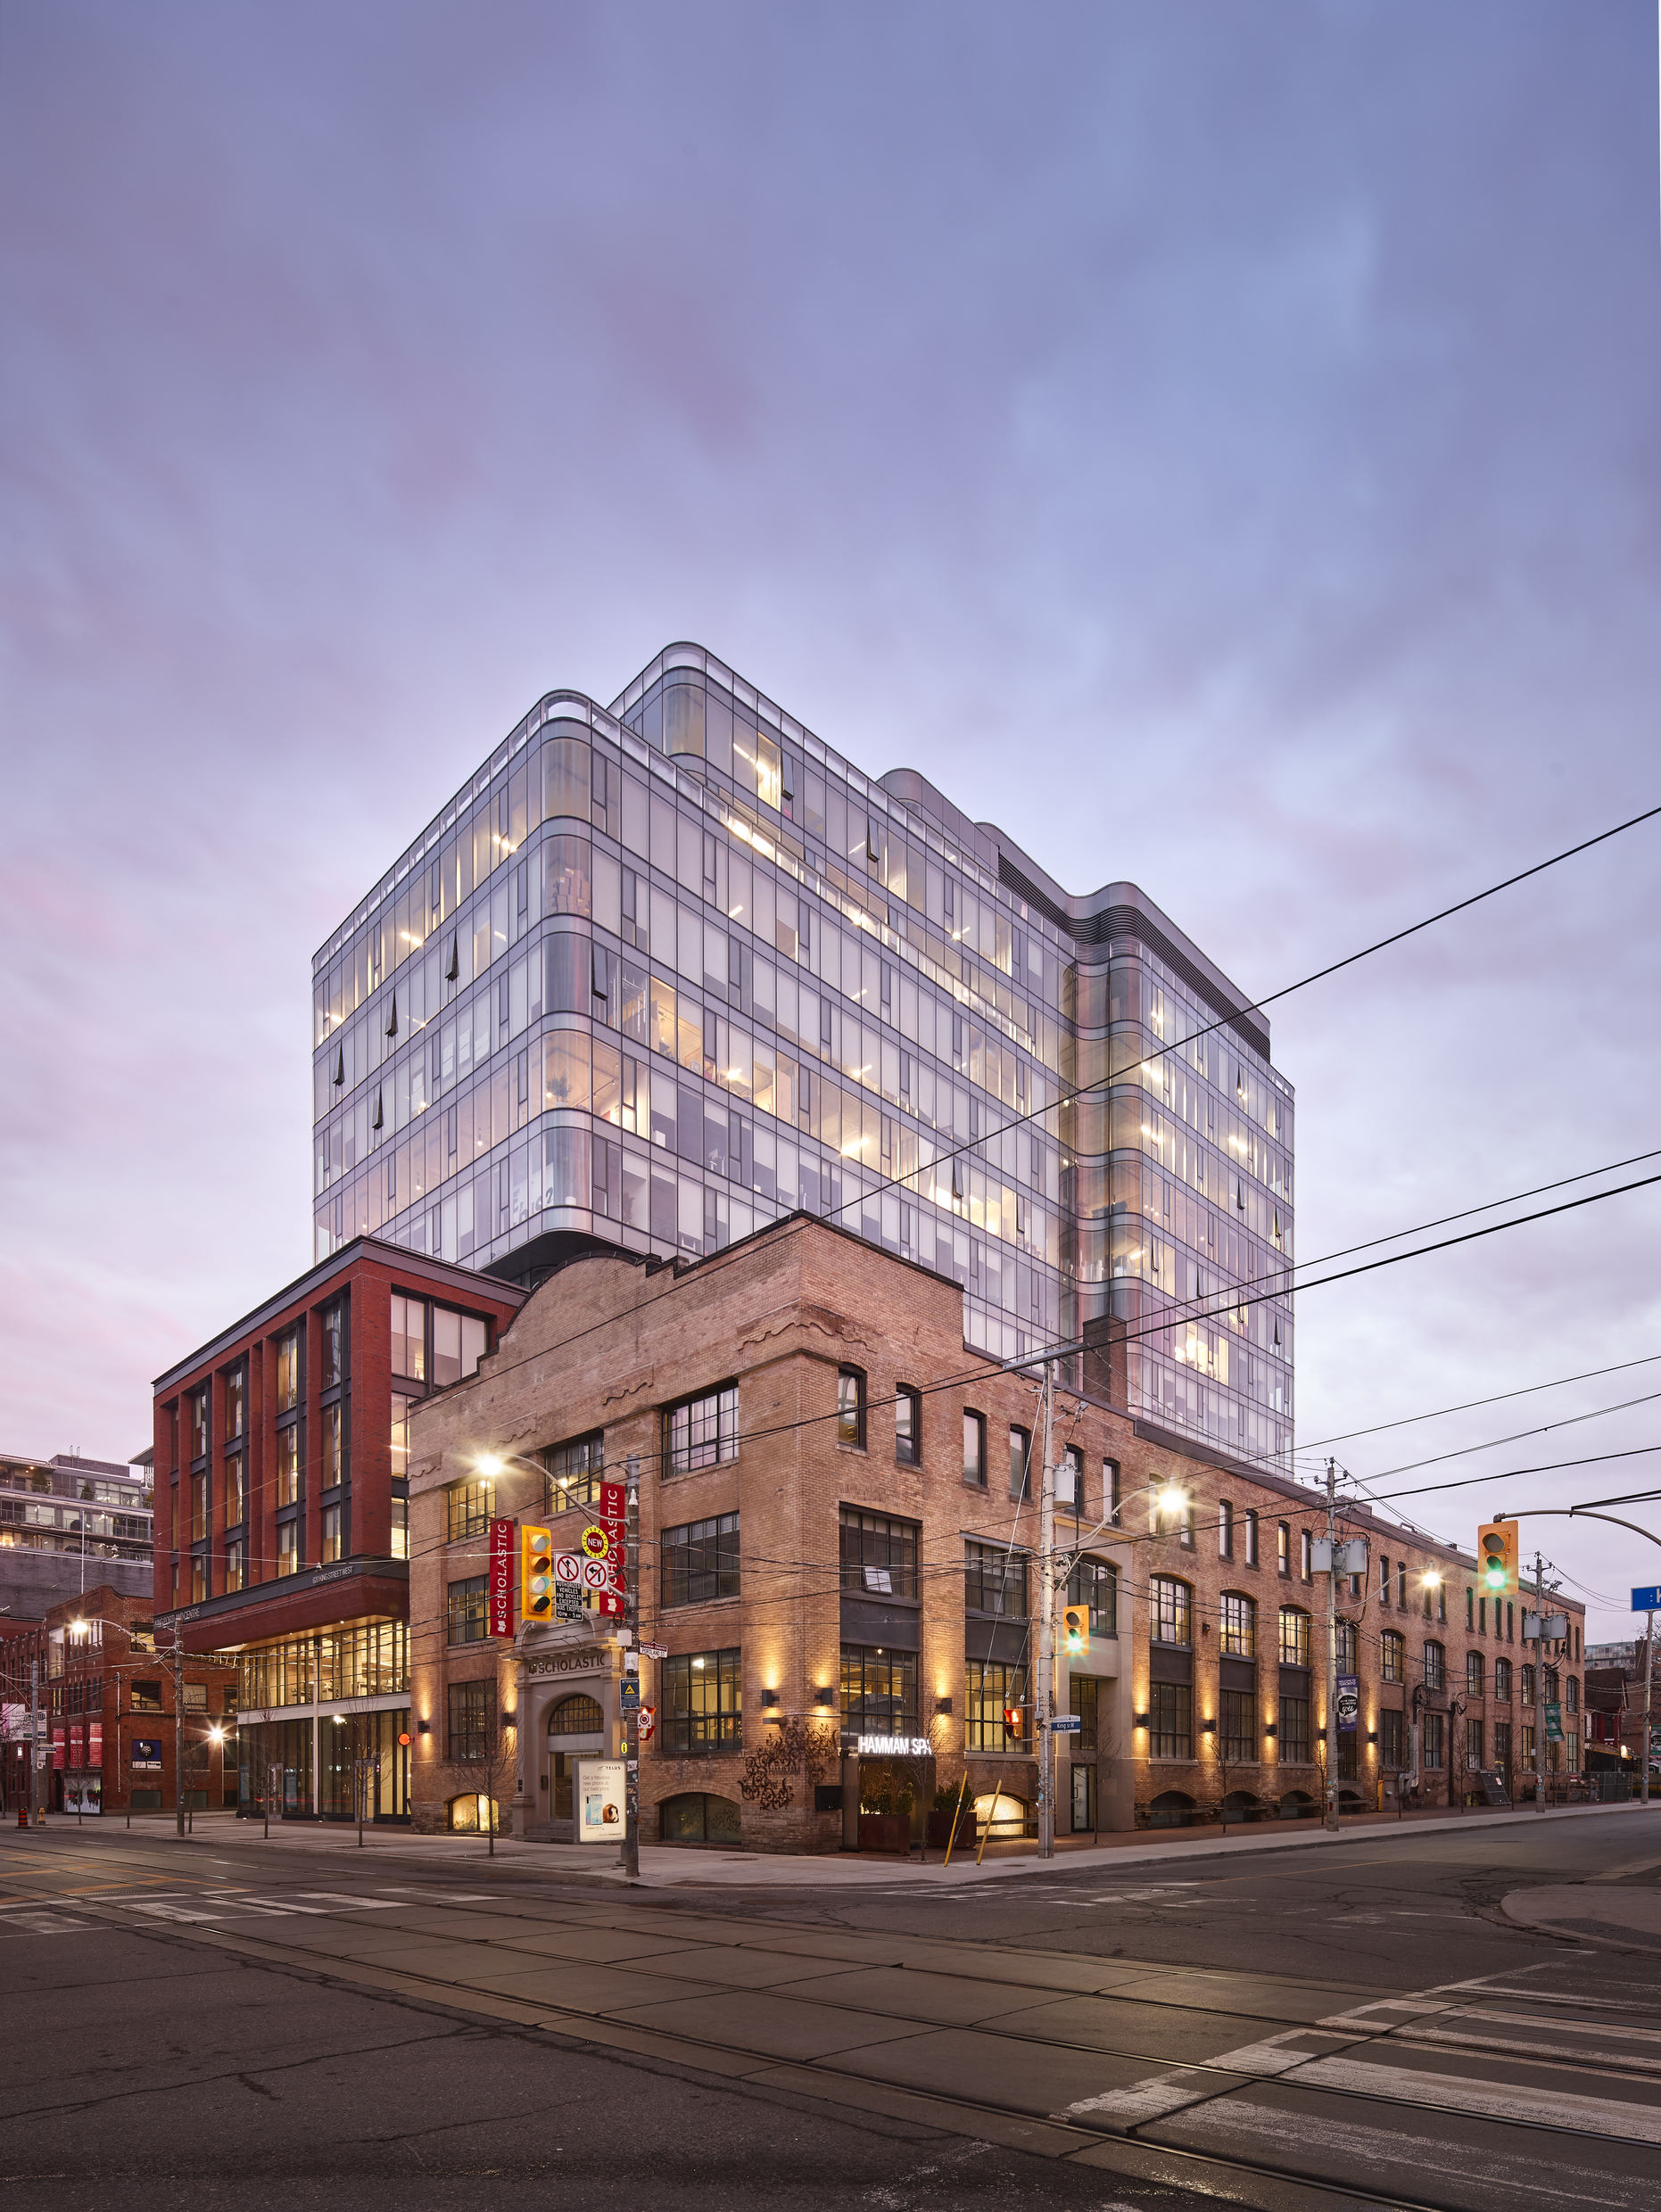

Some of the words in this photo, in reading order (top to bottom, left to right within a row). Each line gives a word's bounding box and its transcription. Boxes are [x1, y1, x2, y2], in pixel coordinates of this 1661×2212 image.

[587, 1538, 603, 1548] NEW
[497, 1524, 508, 1618] SCHOLASTIC
[184, 1607, 201, 1620] CENTRE
[539, 1655, 605, 1674] SCHOLASTIC
[858, 1736, 909, 1754] HAMMAM
[911, 1737, 932, 1755] SPA
